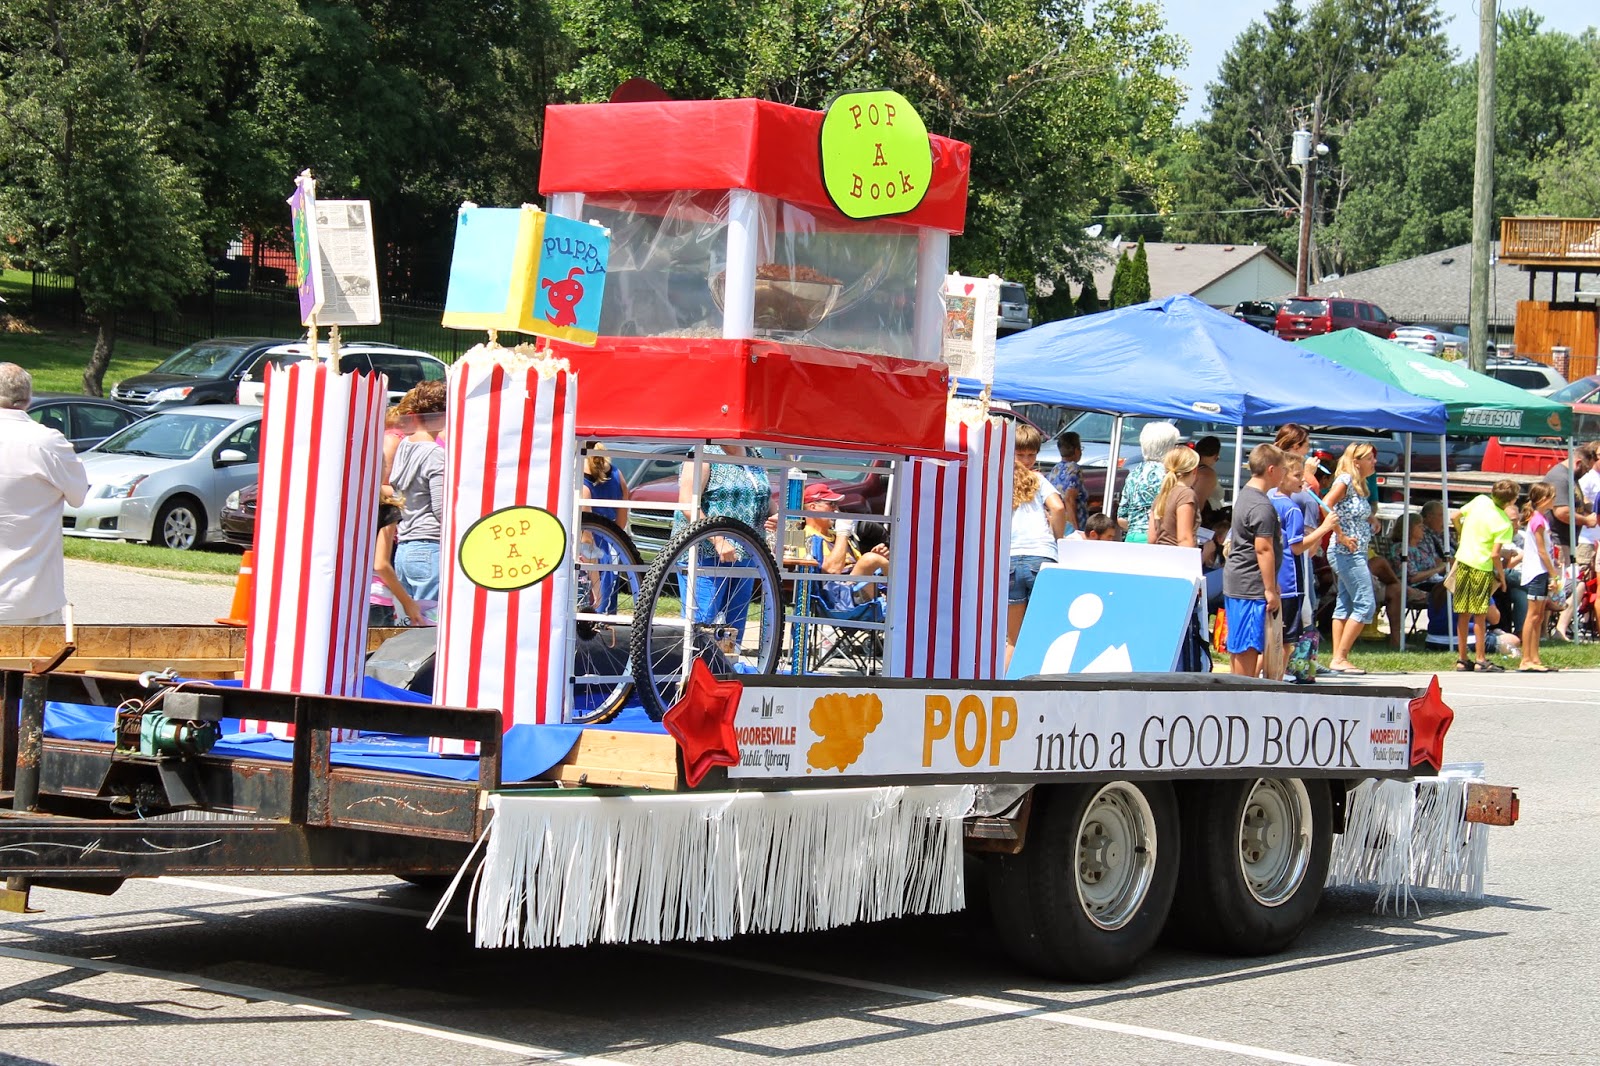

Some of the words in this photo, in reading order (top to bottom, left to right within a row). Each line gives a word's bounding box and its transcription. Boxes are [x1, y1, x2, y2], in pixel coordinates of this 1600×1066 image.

[849, 103, 896, 129] POP
[873, 143, 888, 166] A
[850, 170, 914, 200] Book
[544, 237, 606, 275] puppy
[1461, 407, 1523, 429] STETSON
[507, 543, 522, 558] A
[491, 556, 549, 579] Book
[775, 704, 785, 714] 1912
[735, 726, 797, 746] MOORESVILLE
[922, 694, 1018, 768] POP
[1033, 714, 1099, 771] into
[1109, 731, 1127, 769] a
[1139, 715, 1250, 769] GOOD
[1258, 715, 1361, 768] BOOK
[1370, 728, 1408, 744] MOORESVILLE
[738, 748, 763, 767] Public
[764, 748, 791, 772] Library
